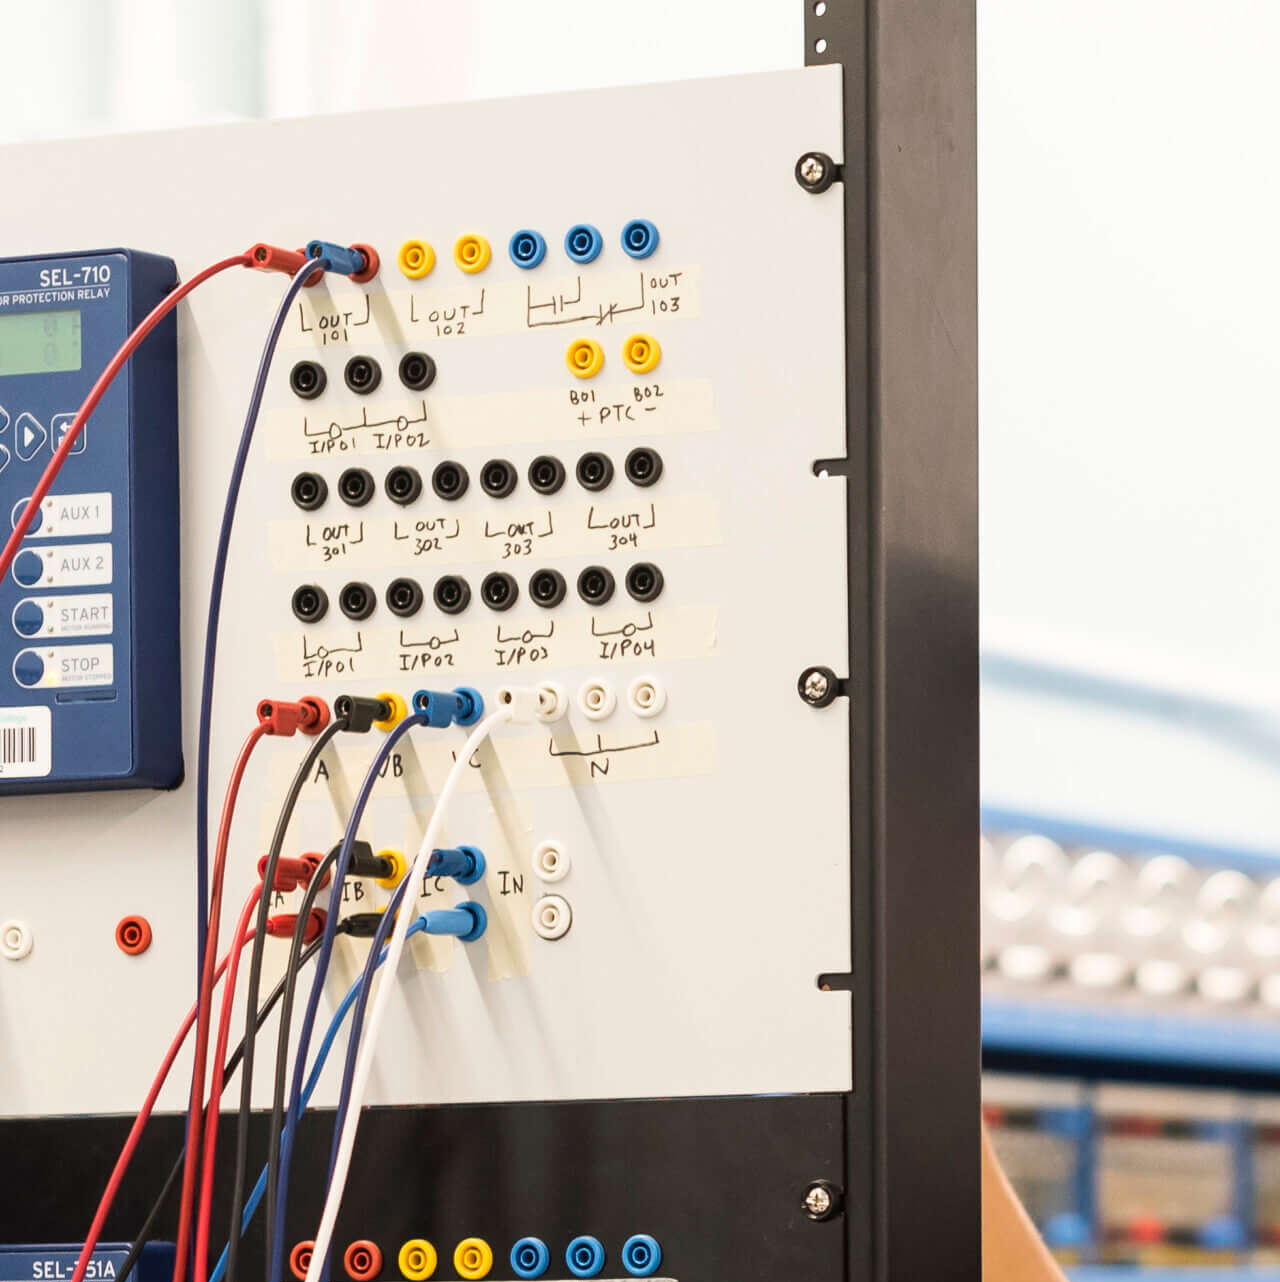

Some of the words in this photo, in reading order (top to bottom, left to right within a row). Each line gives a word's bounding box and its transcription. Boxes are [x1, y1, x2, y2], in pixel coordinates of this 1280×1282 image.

[39, 264, 111, 288] SEL-710
[649, 272, 682, 288] OUT
[12, 291, 75, 305] PROTECTION
[77, 287, 111, 300] RELAY
[428, 305, 470, 322] OUT
[651, 296, 680, 314] 103
[318, 312, 352, 329] OUT
[436, 322, 465, 336] 102
[322, 330, 348, 345] 101
[599, 404, 636, 424] PTC
[60, 506, 92, 521] AUX
[95, 504, 100, 519] 1
[609, 513, 641, 529] OUT
[322, 524, 350, 541] OUT
[415, 518, 447, 532] OUT
[507, 521, 535, 538] OUT
[413, 537, 443, 556] 302
[501, 538, 533, 560] 303
[608, 532, 638, 550] 304
[322, 543, 347, 561] 301
[60, 557, 92, 573] AUX
[95, 556, 105, 570] 2
[60, 606, 110, 622] START
[61, 657, 100, 673] STOP
[590, 757, 610, 778] N
[420, 874, 446, 898] IC
[497, 870, 524, 895] IN
[343, 881, 365, 902] IB
[33, 1260, 116, 1280] SEL-51A
